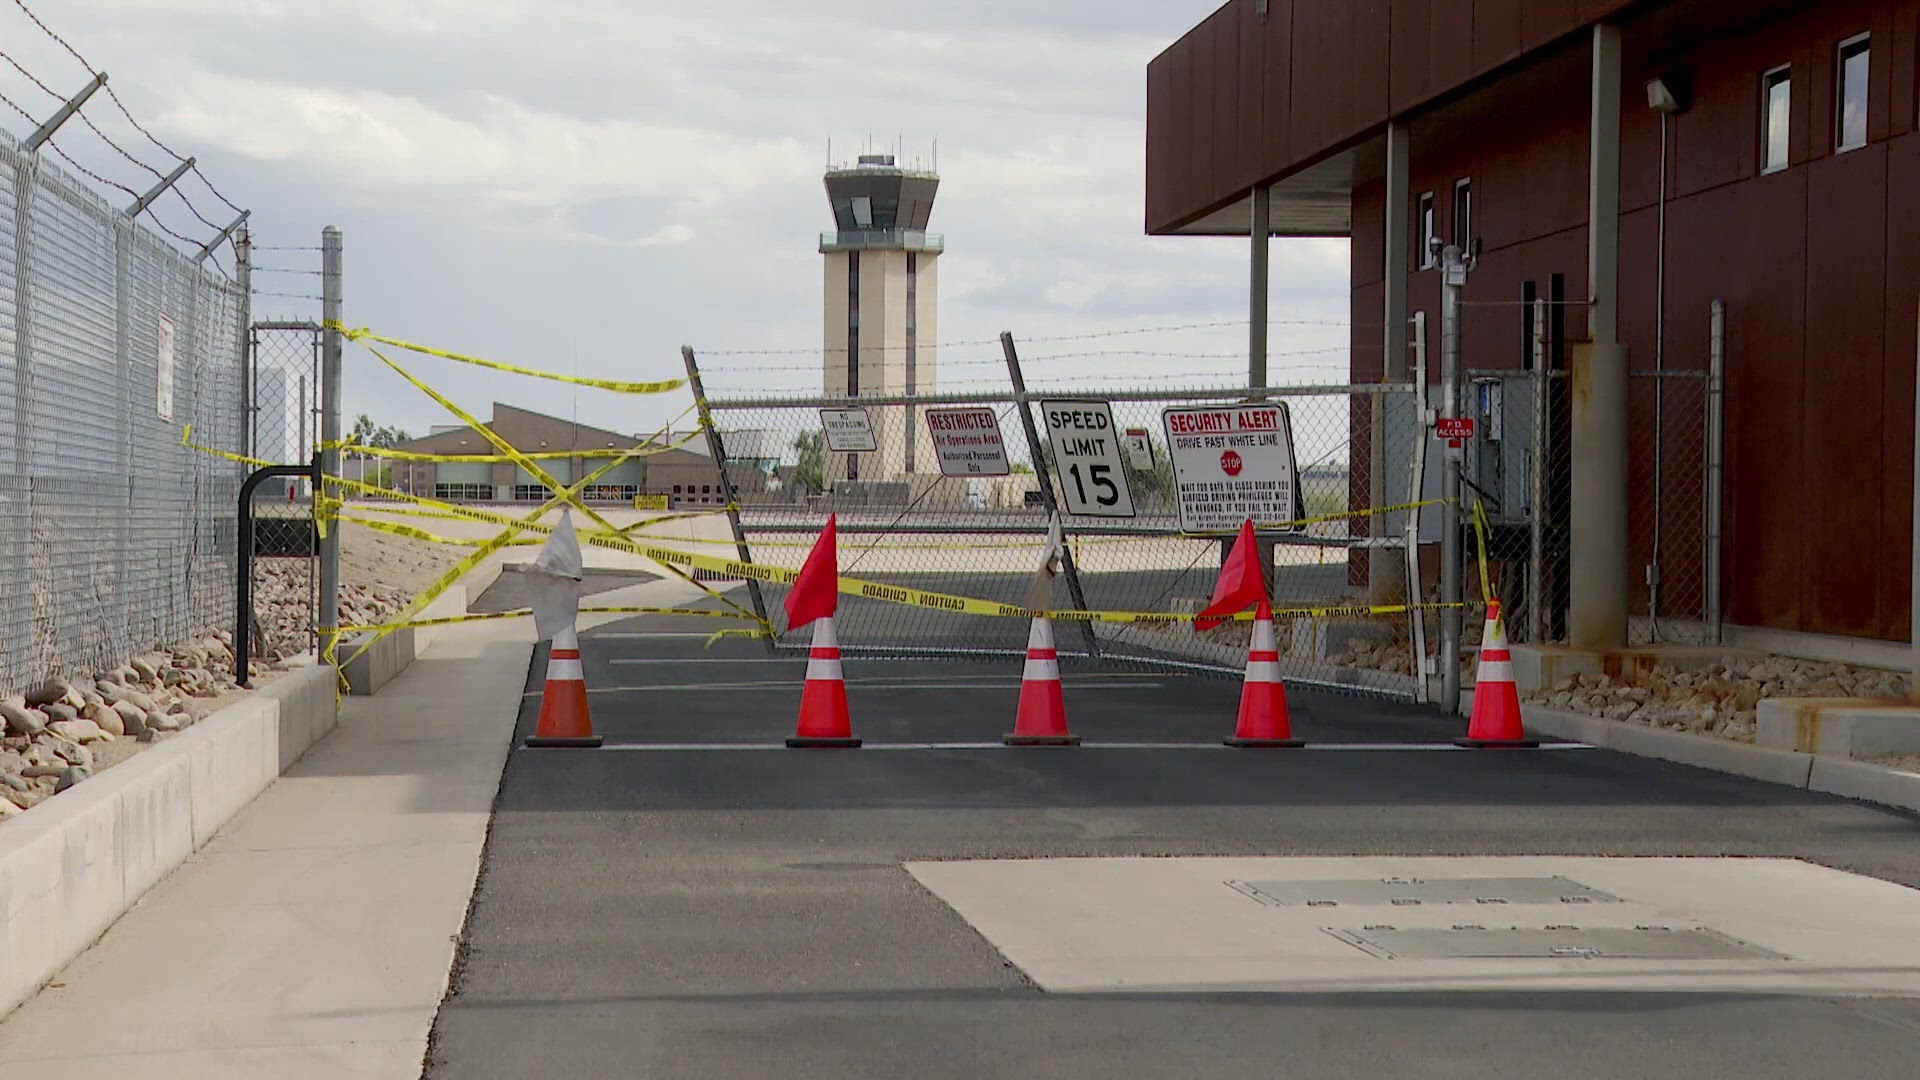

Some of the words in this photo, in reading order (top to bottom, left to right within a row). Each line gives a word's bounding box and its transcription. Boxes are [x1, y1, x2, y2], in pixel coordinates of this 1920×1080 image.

[930, 412, 994, 430] RESTRICTED
[1050, 411, 1108, 429] SPEED
[1170, 412, 1232, 432] SECURITY
[1238, 410, 1278, 428] ALERT
[946, 434, 982, 448] Operations
[983, 433, 1000, 444] Area
[1062, 438, 1105, 456] LIMIT
[1176, 437, 1202, 450] DRIVE
[1228, 436, 1256, 447] WHITE
[1258, 434, 1278, 446] LINE
[968, 463, 980, 472] Only
[1222, 458, 1240, 468] STOP
[1070, 463, 1118, 506] 15
[1180, 483, 1194, 492] WAIT
[1210, 482, 1224, 492] GATE
[1234, 482, 1252, 490] CLOSE
[1254, 481, 1276, 490] BEHIND
[1278, 481, 1288, 490] YOU
[1182, 493, 1208, 502] AIRFIELD
[1212, 492, 1236, 502] DRIVING
[1238, 492, 1272, 501] PRIVILEGES
[1274, 491, 1288, 500] WILL
[1186, 504, 1193, 513] BE
[1226, 504, 1232, 512] IF
[1234, 503, 1246, 512] YOU
[1248, 502, 1261, 512] FAIL
[1264, 502, 1270, 512] TO
